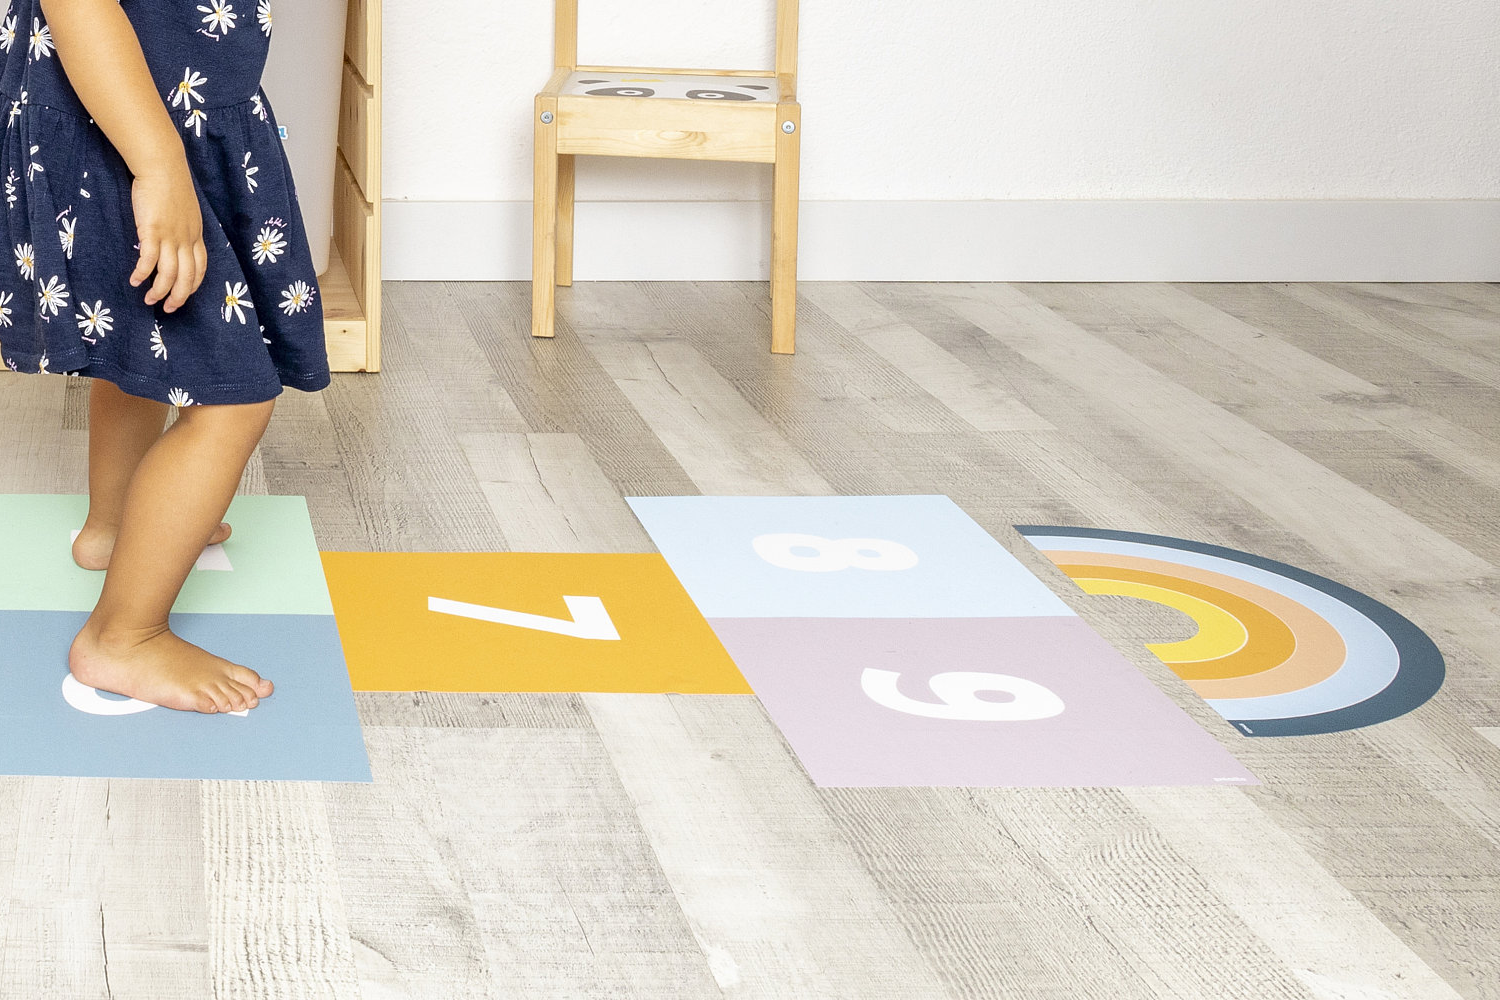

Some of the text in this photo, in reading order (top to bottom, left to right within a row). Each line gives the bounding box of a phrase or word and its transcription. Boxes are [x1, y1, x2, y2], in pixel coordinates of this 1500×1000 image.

[752, 533, 920, 573] 8
[428, 595, 621, 639] 7
[860, 667, 1066, 722] 9
